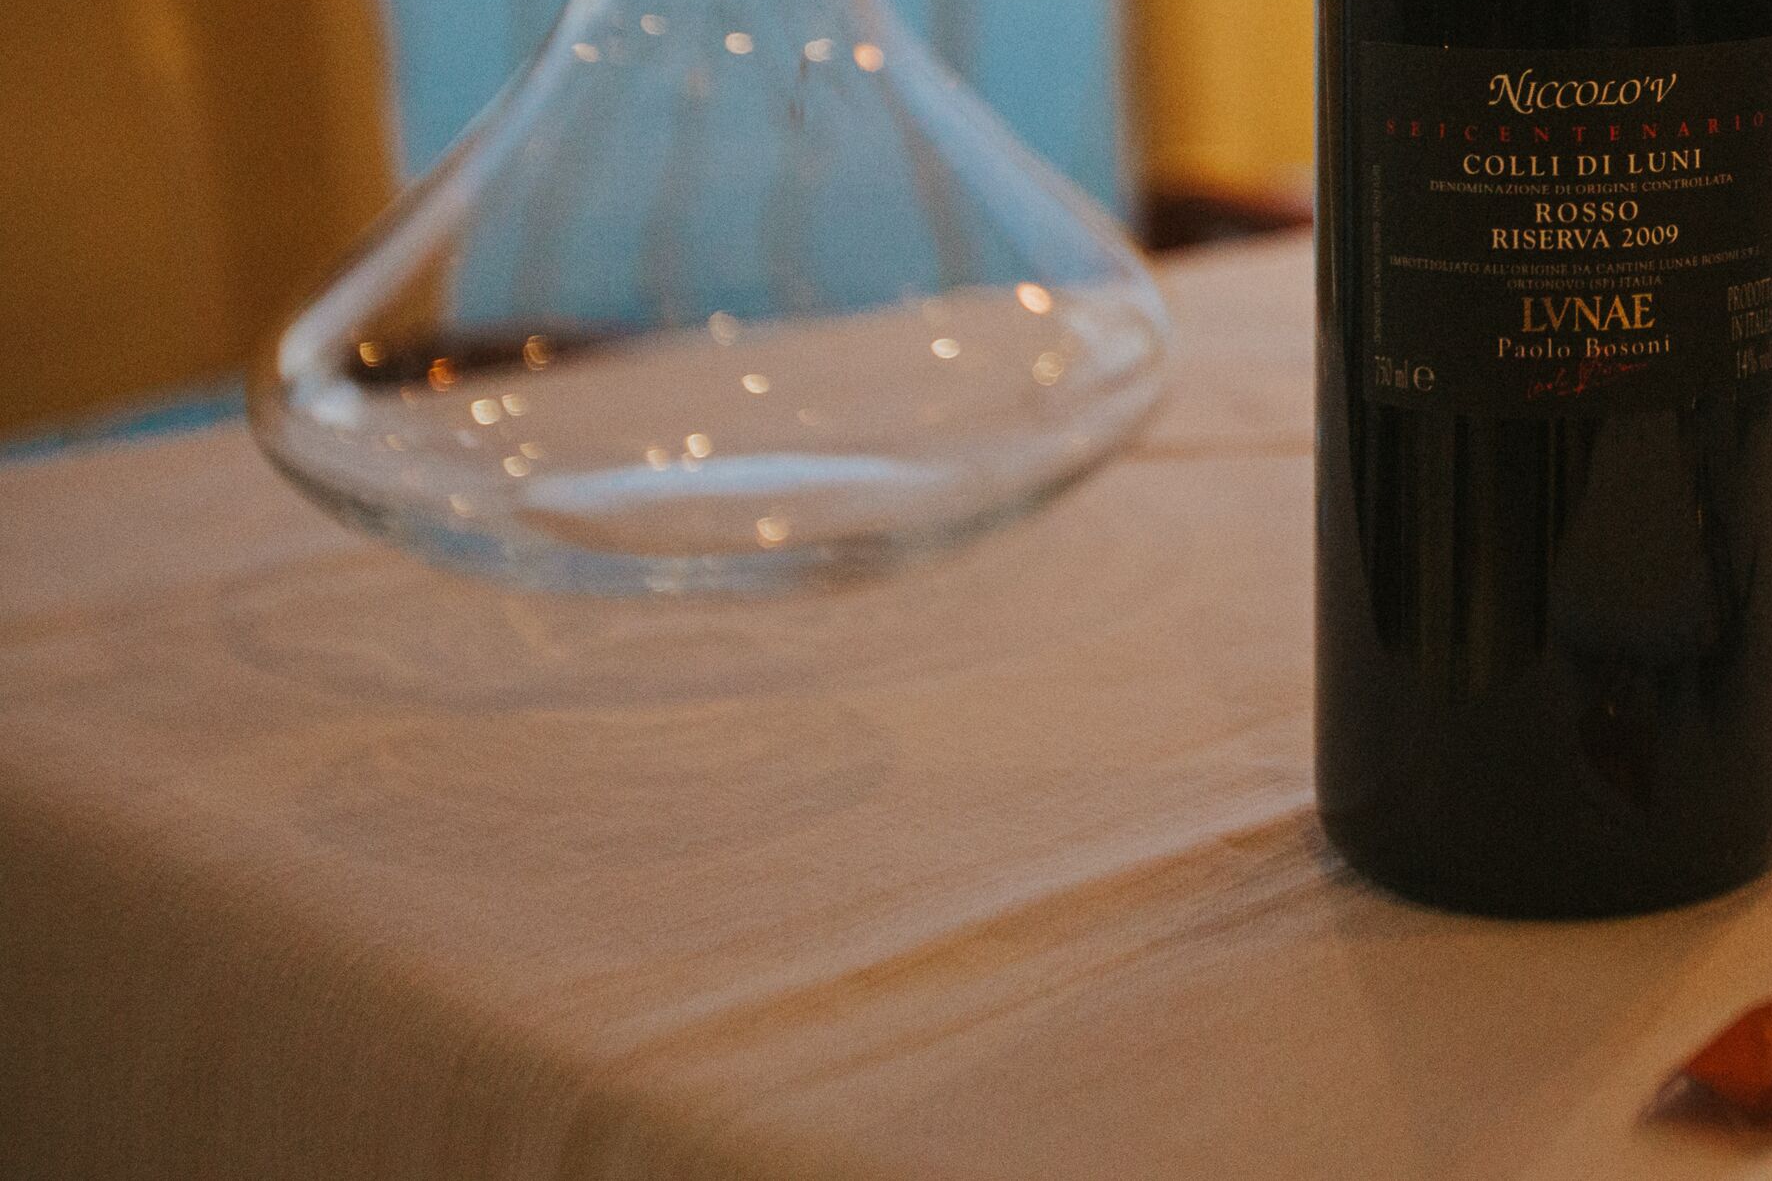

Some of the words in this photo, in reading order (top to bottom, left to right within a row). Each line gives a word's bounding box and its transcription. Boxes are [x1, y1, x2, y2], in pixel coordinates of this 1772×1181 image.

[1384, 110, 1768, 144] SEICENTENARIO
[1461, 153, 1560, 178] COLLI
[1576, 152, 1611, 177] DI
[1627, 147, 1704, 175] LUNI
[1429, 179, 1550, 196] DENOMINAZIONE
[1554, 183, 1572, 196] DI
[1575, 181, 1638, 195] ORIGINE
[1640, 172, 1735, 194] CONTROLLATA
[1534, 199, 1640, 225] ROSSO
[1489, 227, 1611, 252] RISERVA
[1620, 223, 1680, 249] 2009
[1520, 292, 1657, 334] LVNAE
[1496, 336, 1571, 360] Paolo
[1584, 334, 1672, 359] Bosoni
